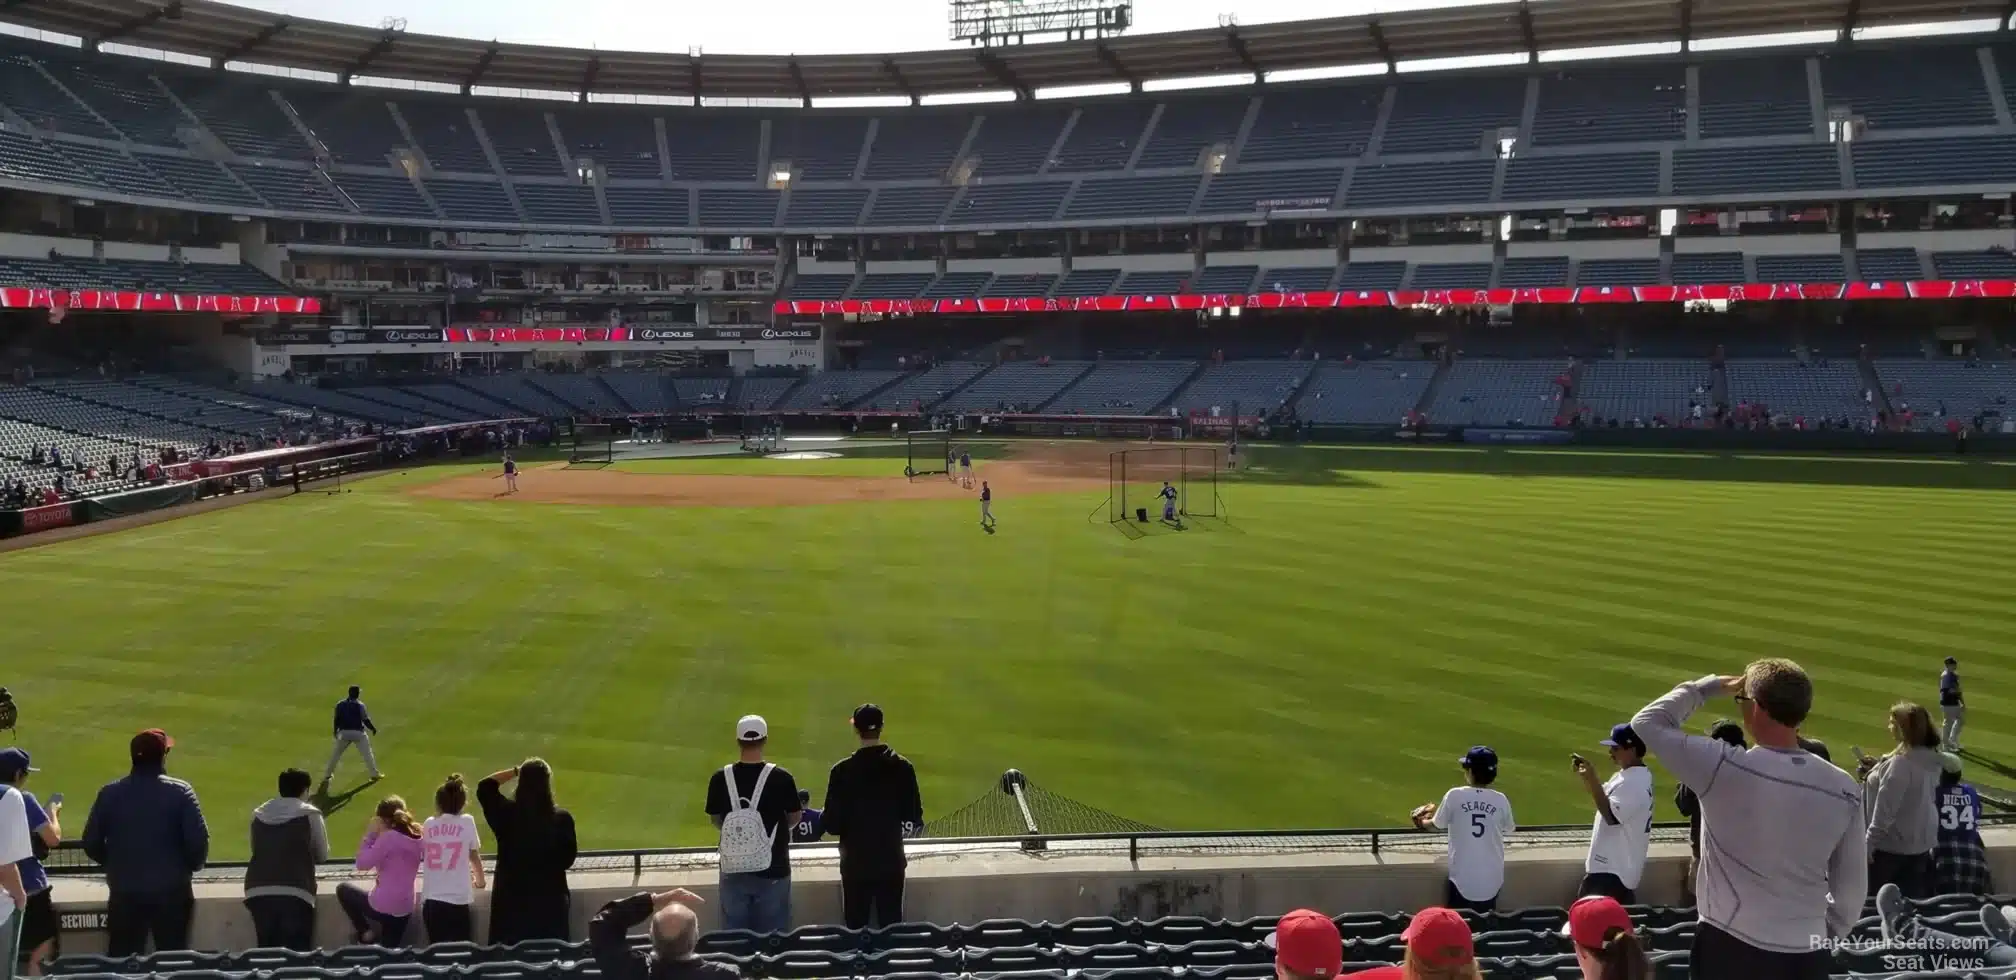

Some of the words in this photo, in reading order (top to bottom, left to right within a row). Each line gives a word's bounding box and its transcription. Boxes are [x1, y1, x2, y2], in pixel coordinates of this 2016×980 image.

[400, 332, 440, 340] LEXUS
[40, 508, 71, 522] TOYOTA
[1943, 794, 1972, 806] NIETO
[1461, 801, 1497, 816] SEAGER
[1940, 805, 1975, 830] 34
[799, 821, 813, 836] 91
[1471, 813, 1486, 838] 5
[426, 842, 463, 870] 27
[61, 913, 98, 929] SECTION
